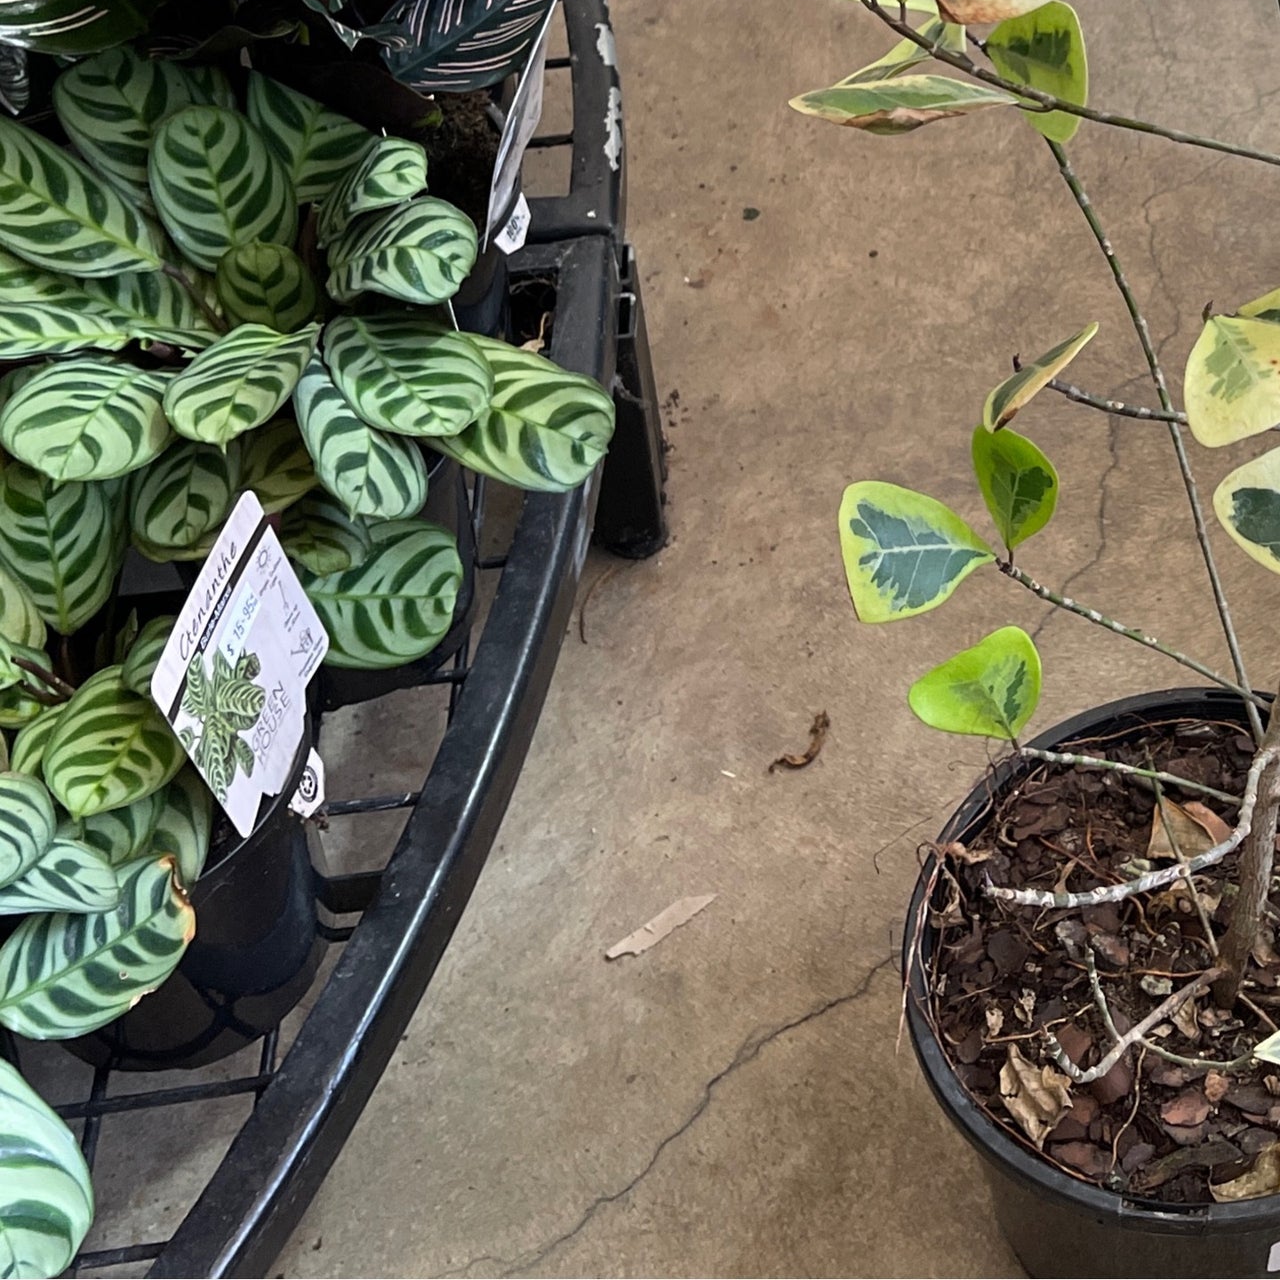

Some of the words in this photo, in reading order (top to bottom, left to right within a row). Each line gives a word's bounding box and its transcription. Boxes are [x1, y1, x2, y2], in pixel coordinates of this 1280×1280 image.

[179, 541, 237, 661] Ctenanthe
[251, 680, 284, 752] GREEN
[257, 690, 290, 766] HOUSE
